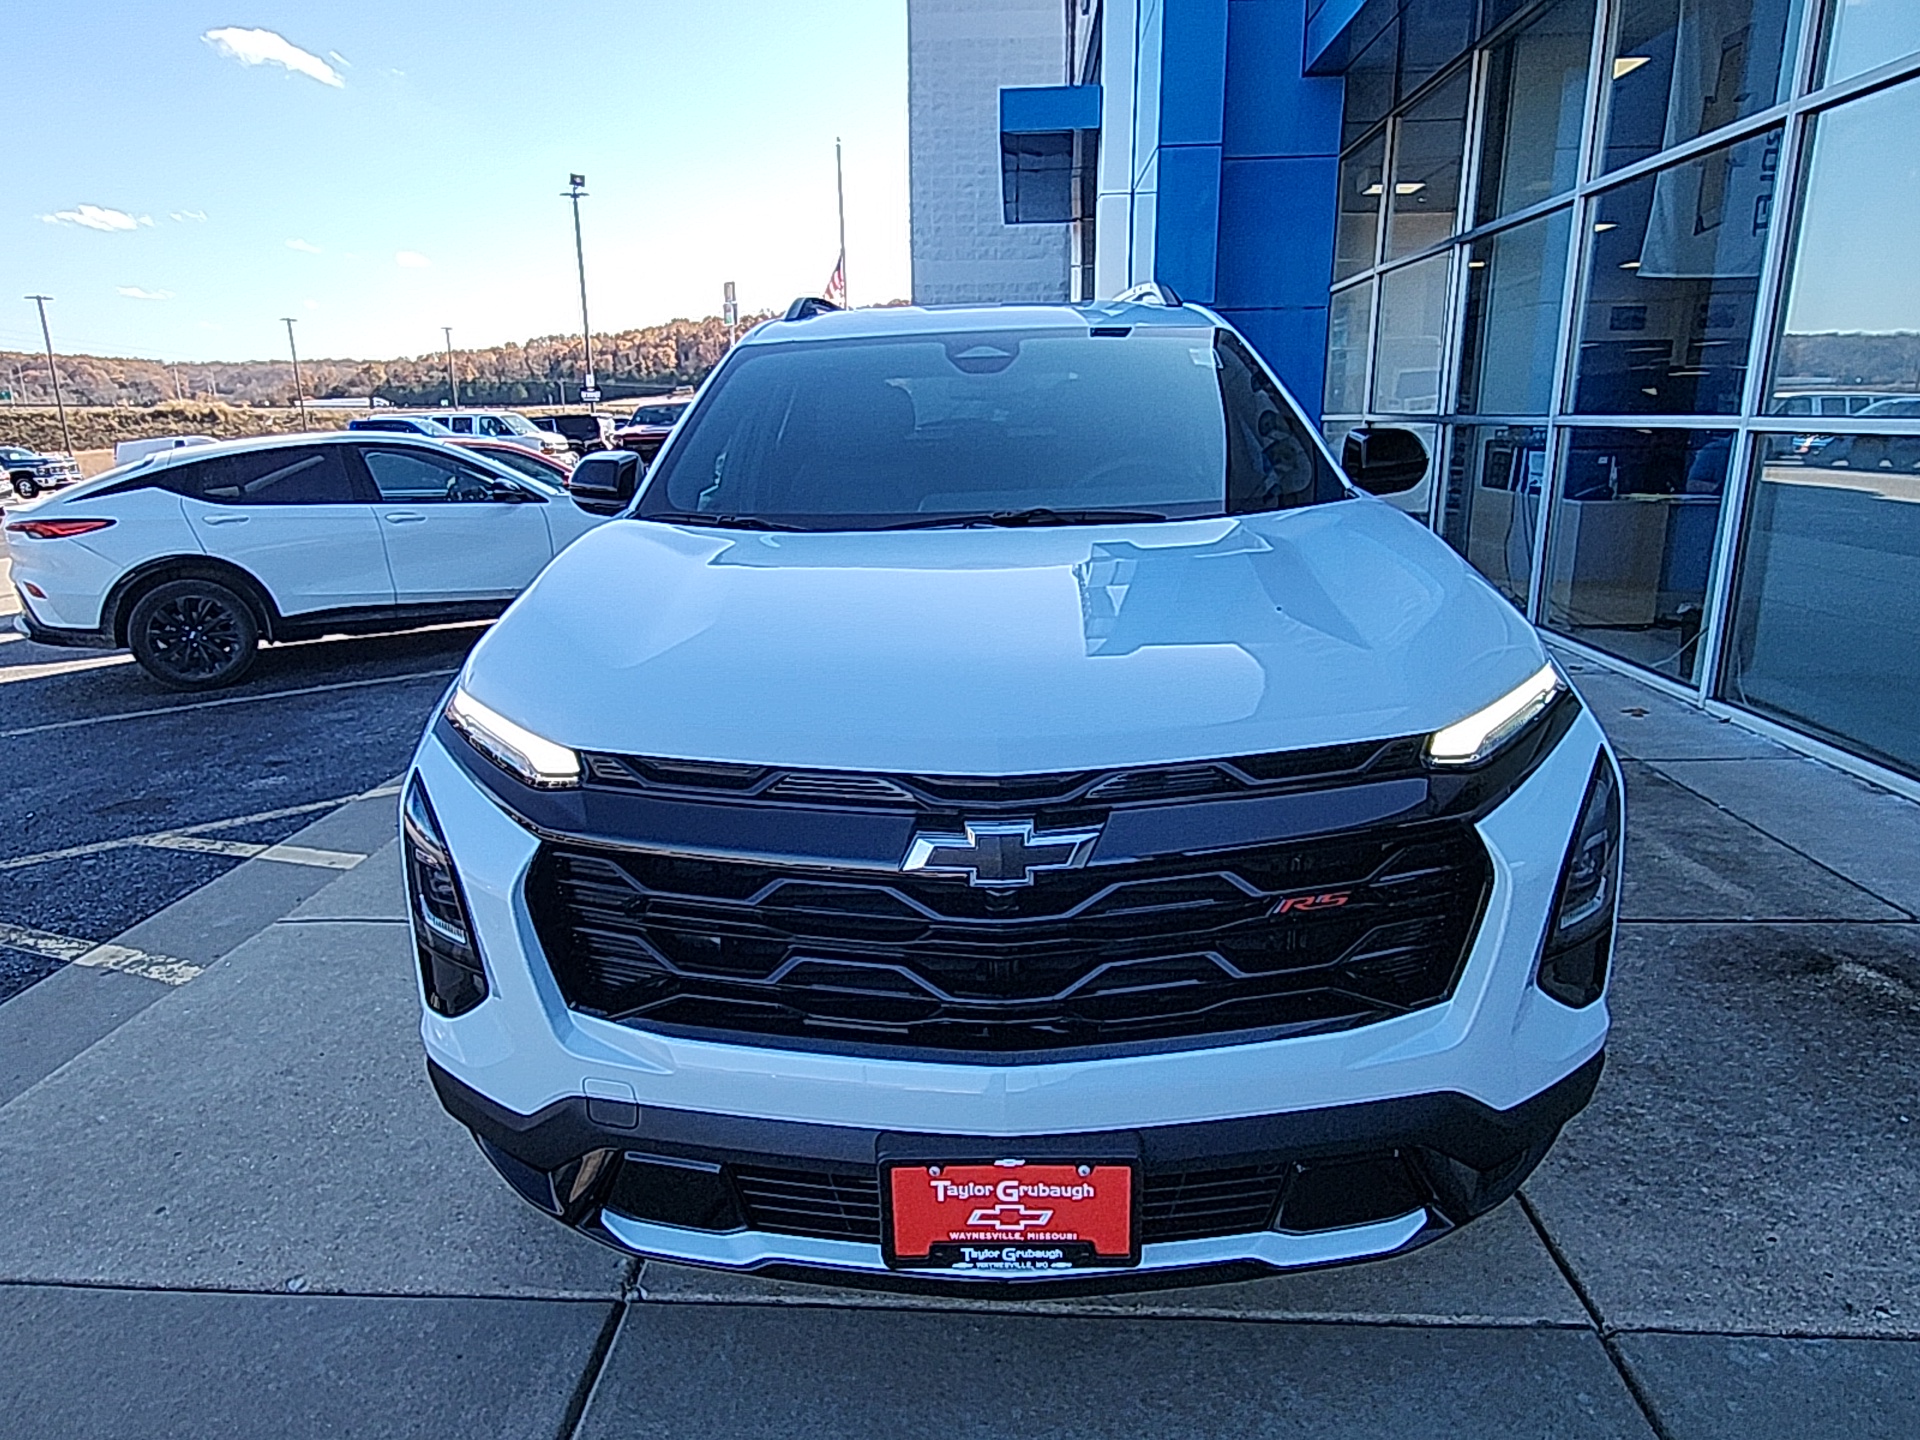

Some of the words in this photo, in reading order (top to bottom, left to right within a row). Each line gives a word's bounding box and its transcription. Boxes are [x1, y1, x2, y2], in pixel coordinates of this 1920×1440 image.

[1273, 891, 1351, 914] RS
[930, 1180, 994, 1202] Taylor
[996, 1180, 1094, 1202] Grubaugh
[949, 1232, 1024, 1241] WAYNESVILLE,
[1027, 1232, 1077, 1240] MISSOURI
[960, 1247, 1000, 1262] Taylor
[1002, 1247, 1063, 1262] Grubaugh
